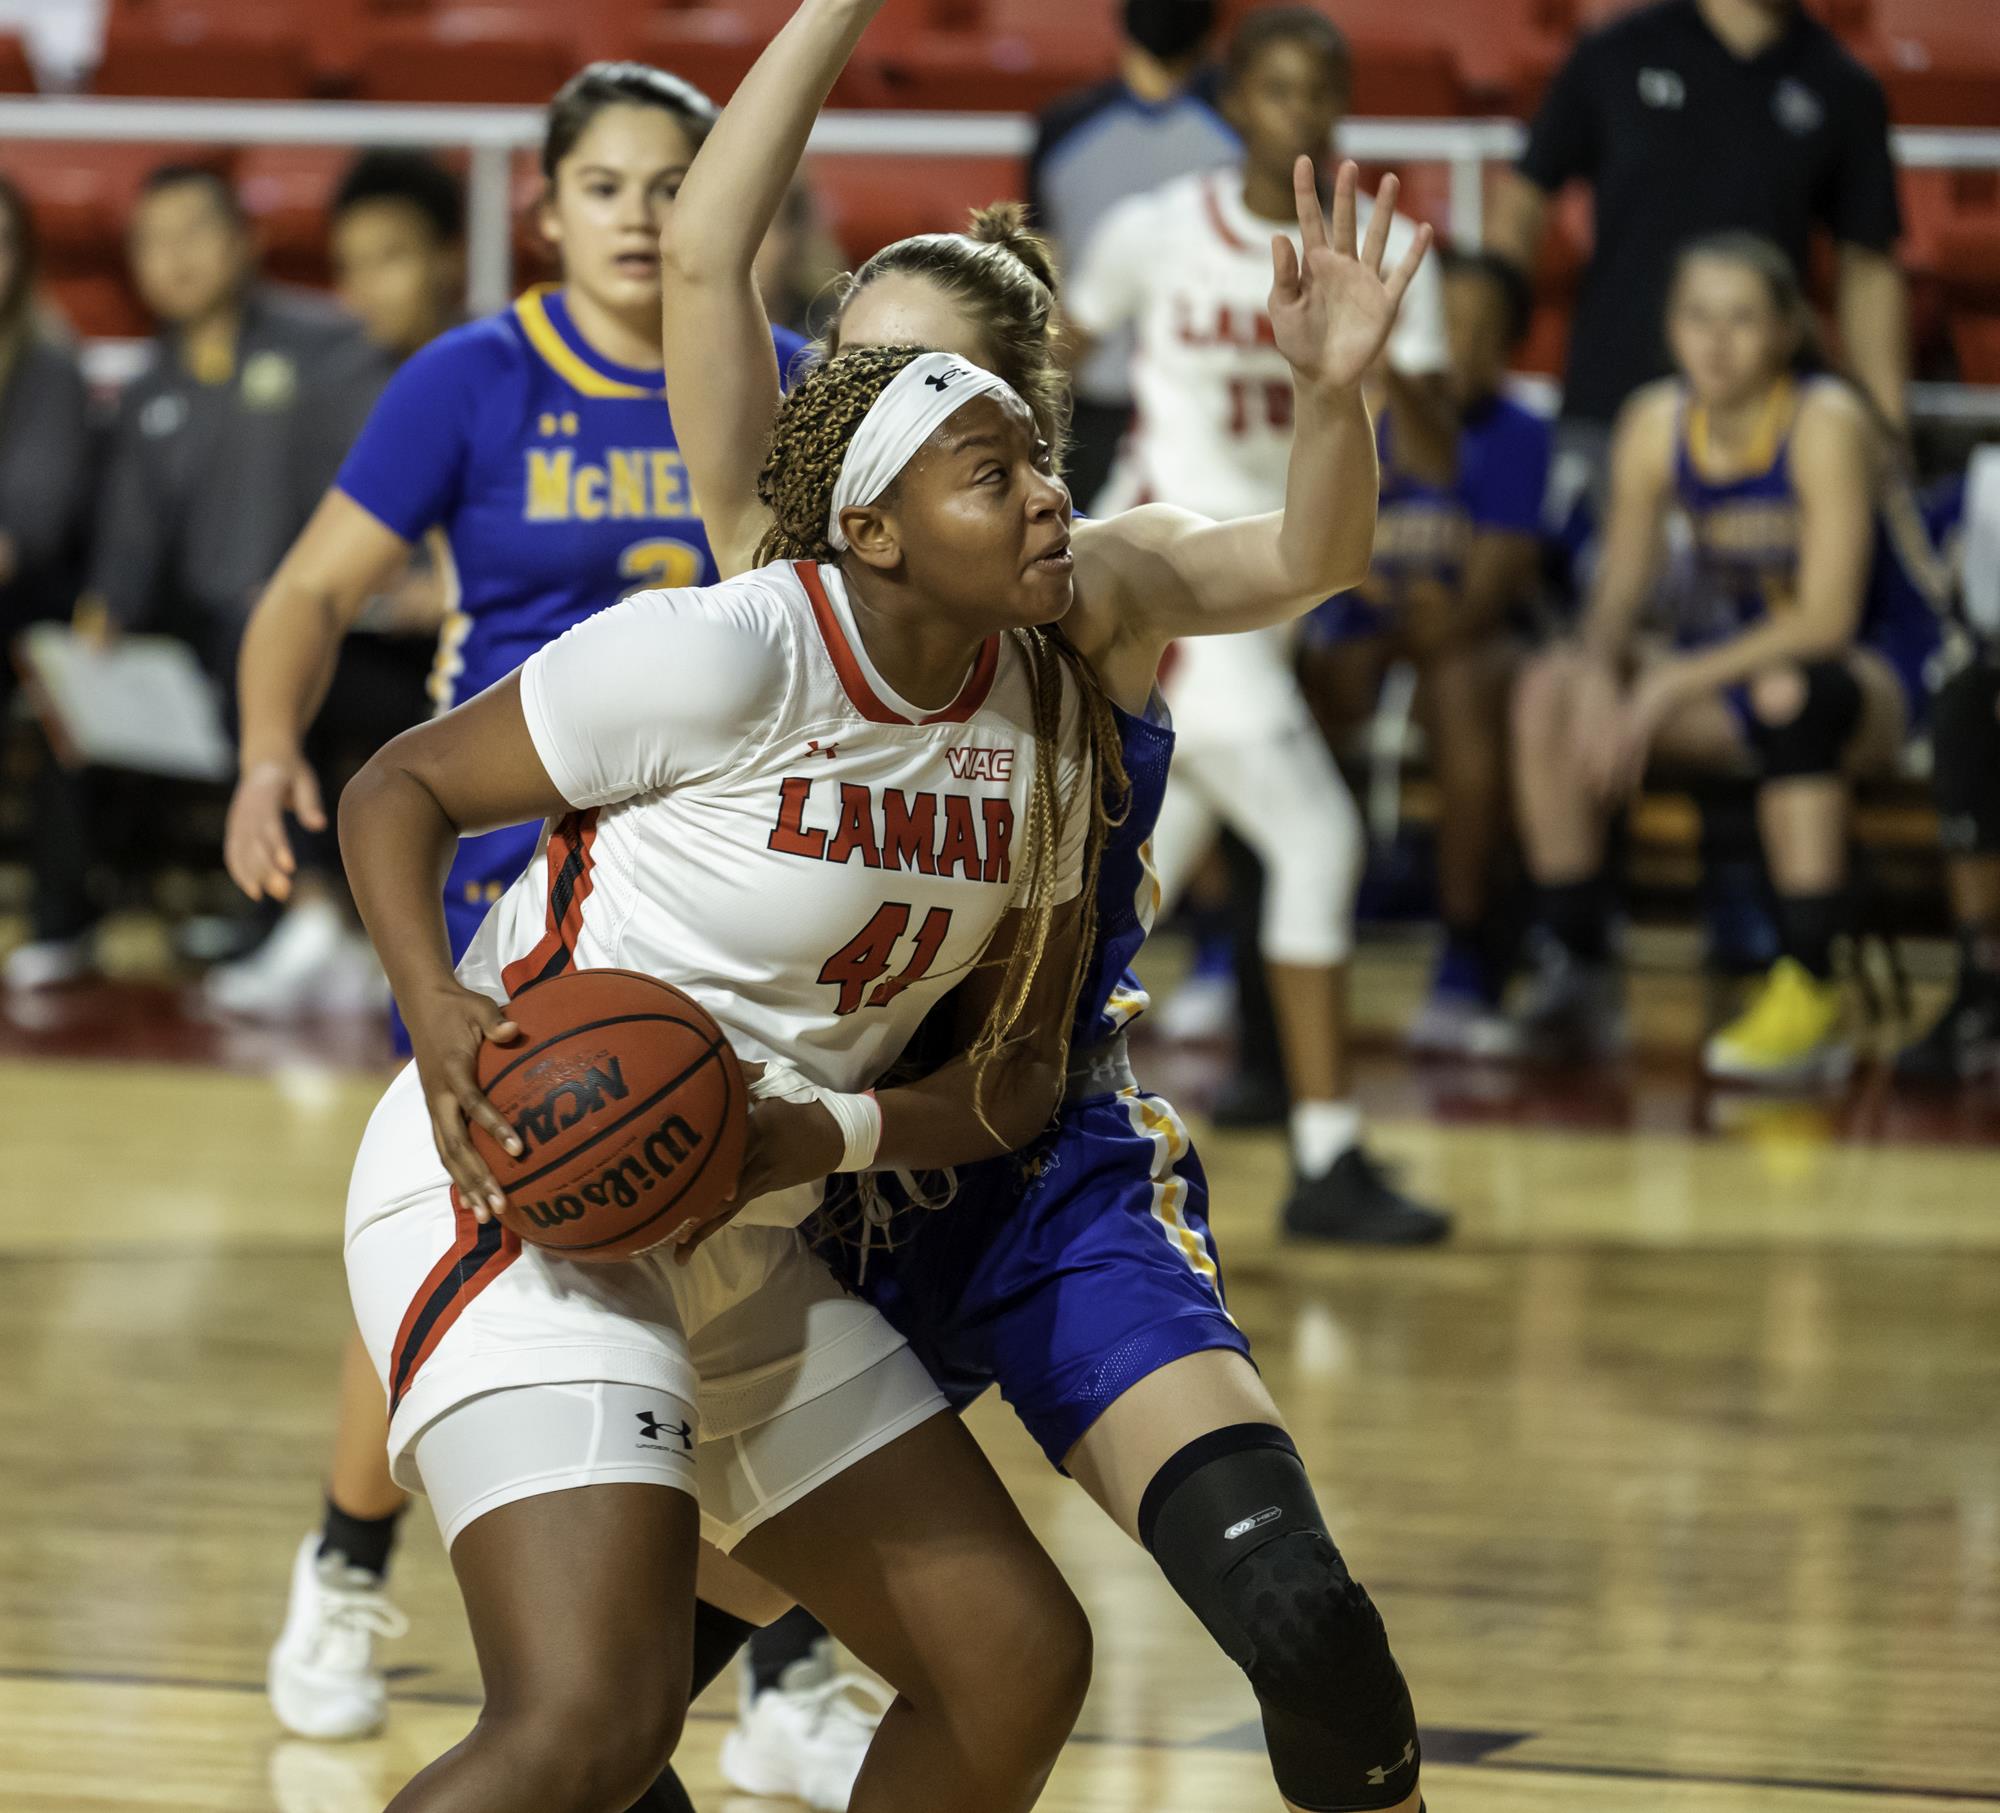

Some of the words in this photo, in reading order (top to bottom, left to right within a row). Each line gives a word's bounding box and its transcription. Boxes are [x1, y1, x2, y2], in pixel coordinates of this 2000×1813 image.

[945, 747, 1015, 781] WAC
[767, 777, 1014, 883] LAMAR
[816, 901, 953, 1016] 41
[520, 1113, 702, 1229] Wilson
